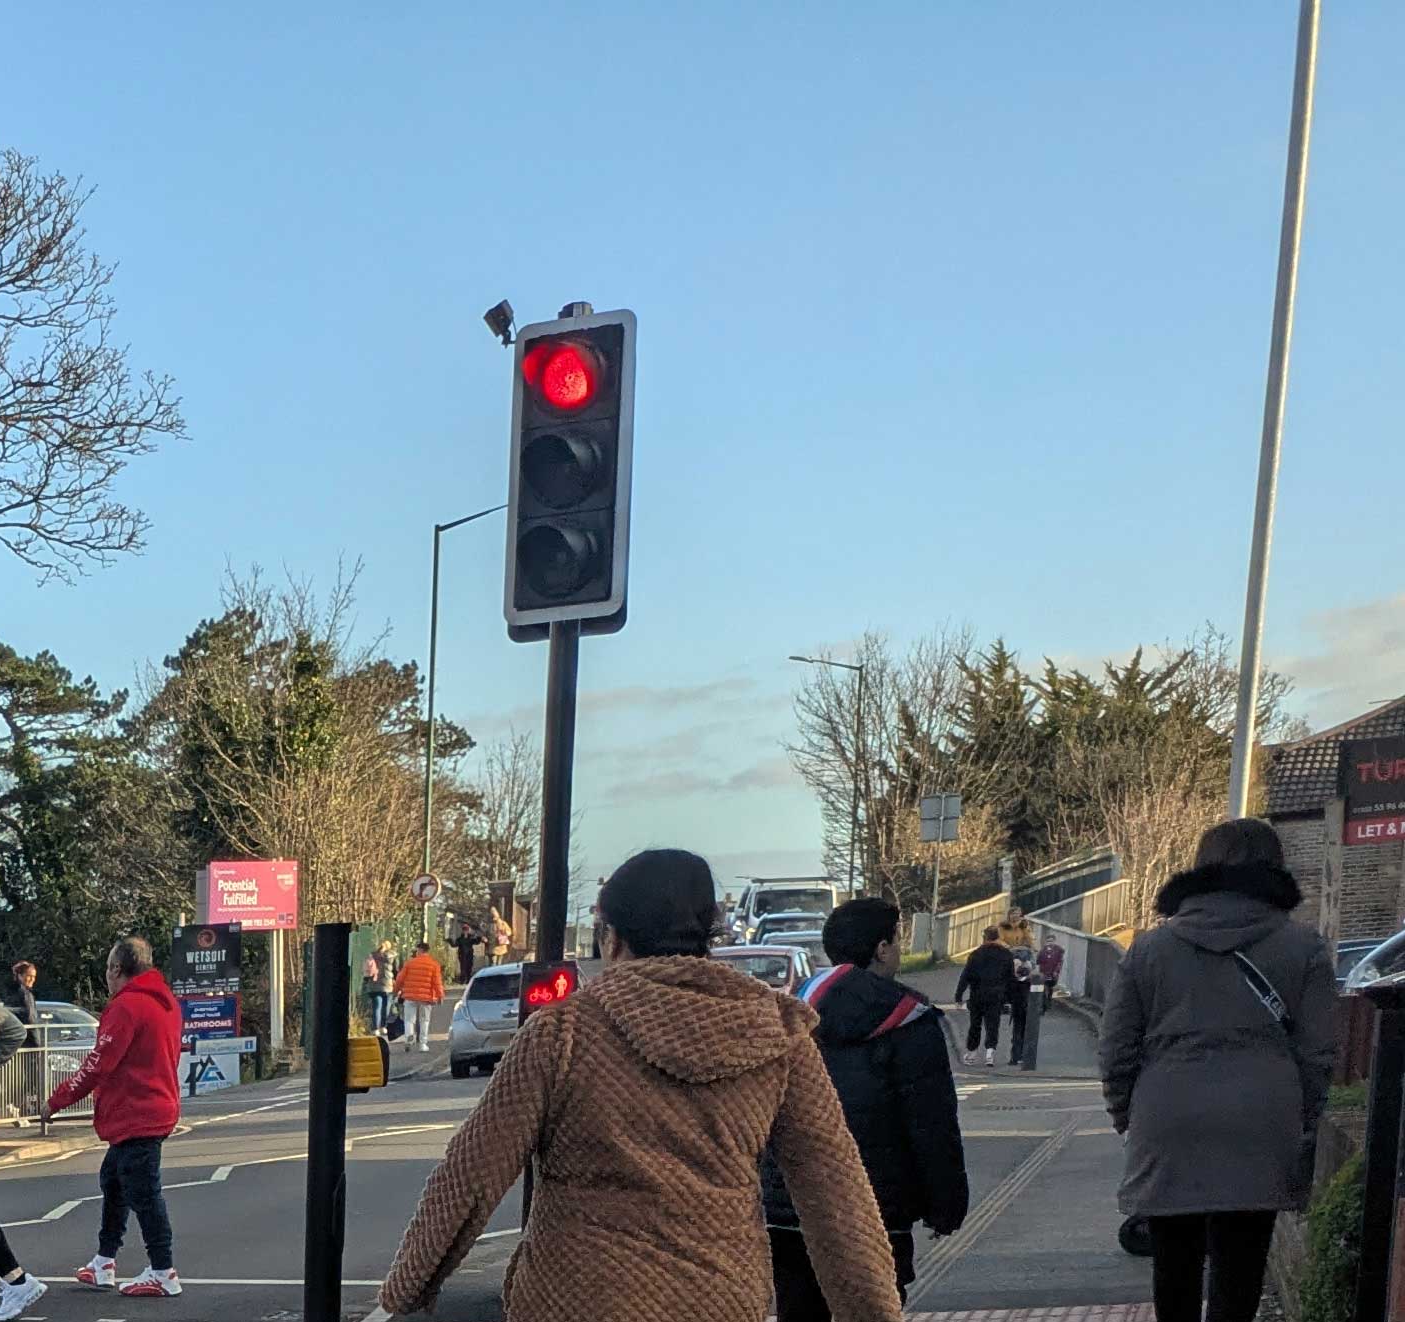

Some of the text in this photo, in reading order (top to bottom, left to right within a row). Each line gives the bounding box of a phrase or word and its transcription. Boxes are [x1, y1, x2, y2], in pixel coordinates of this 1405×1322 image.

[1357, 823, 1384, 838] LET
[1386, 822, 1397, 836] &
[218, 879, 258, 892] Potential,
[223, 893, 257, 906] fulfilled
[184, 1019, 232, 1029] BATHROOMS
